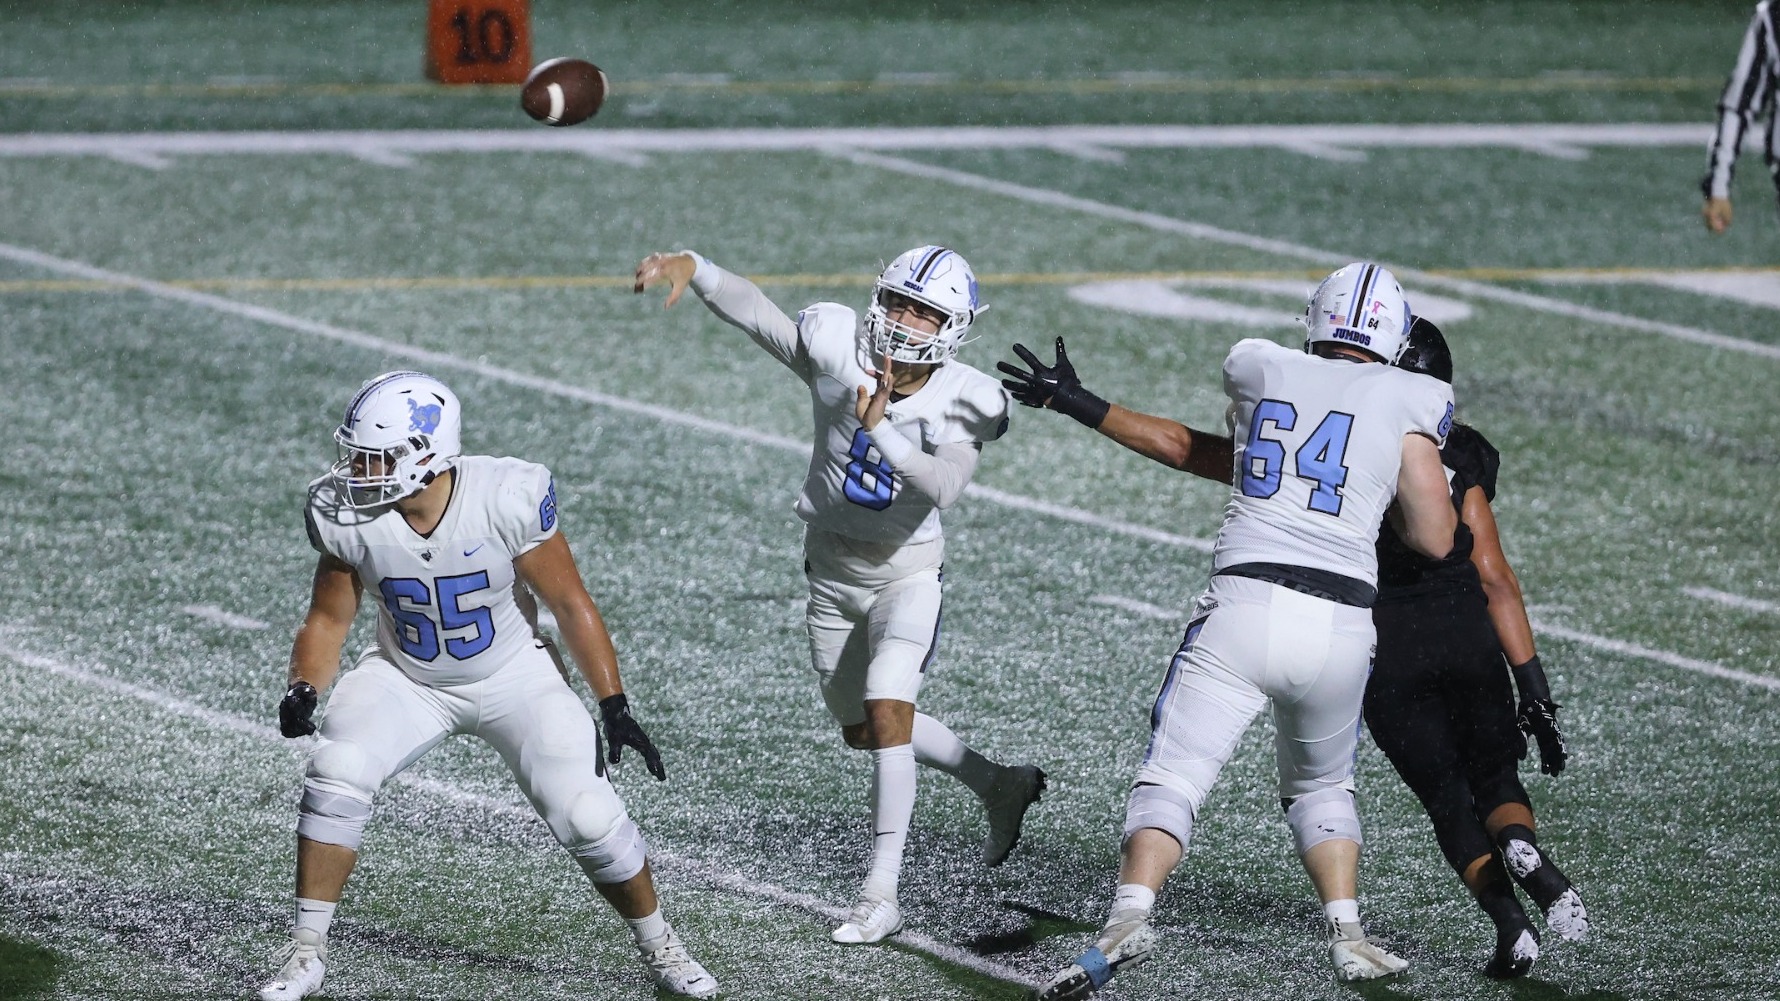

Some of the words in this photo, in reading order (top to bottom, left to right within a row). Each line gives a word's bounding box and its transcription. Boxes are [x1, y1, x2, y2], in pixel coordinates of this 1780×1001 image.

[452, 9, 513, 64] 10
[1333, 328, 1371, 346] JUMBOS
[1368, 317, 1379, 330] 64
[1437, 400, 1453, 438] 6
[842, 427, 894, 511] 8
[1242, 398, 1355, 517] 64
[379, 570, 496, 662] 65
